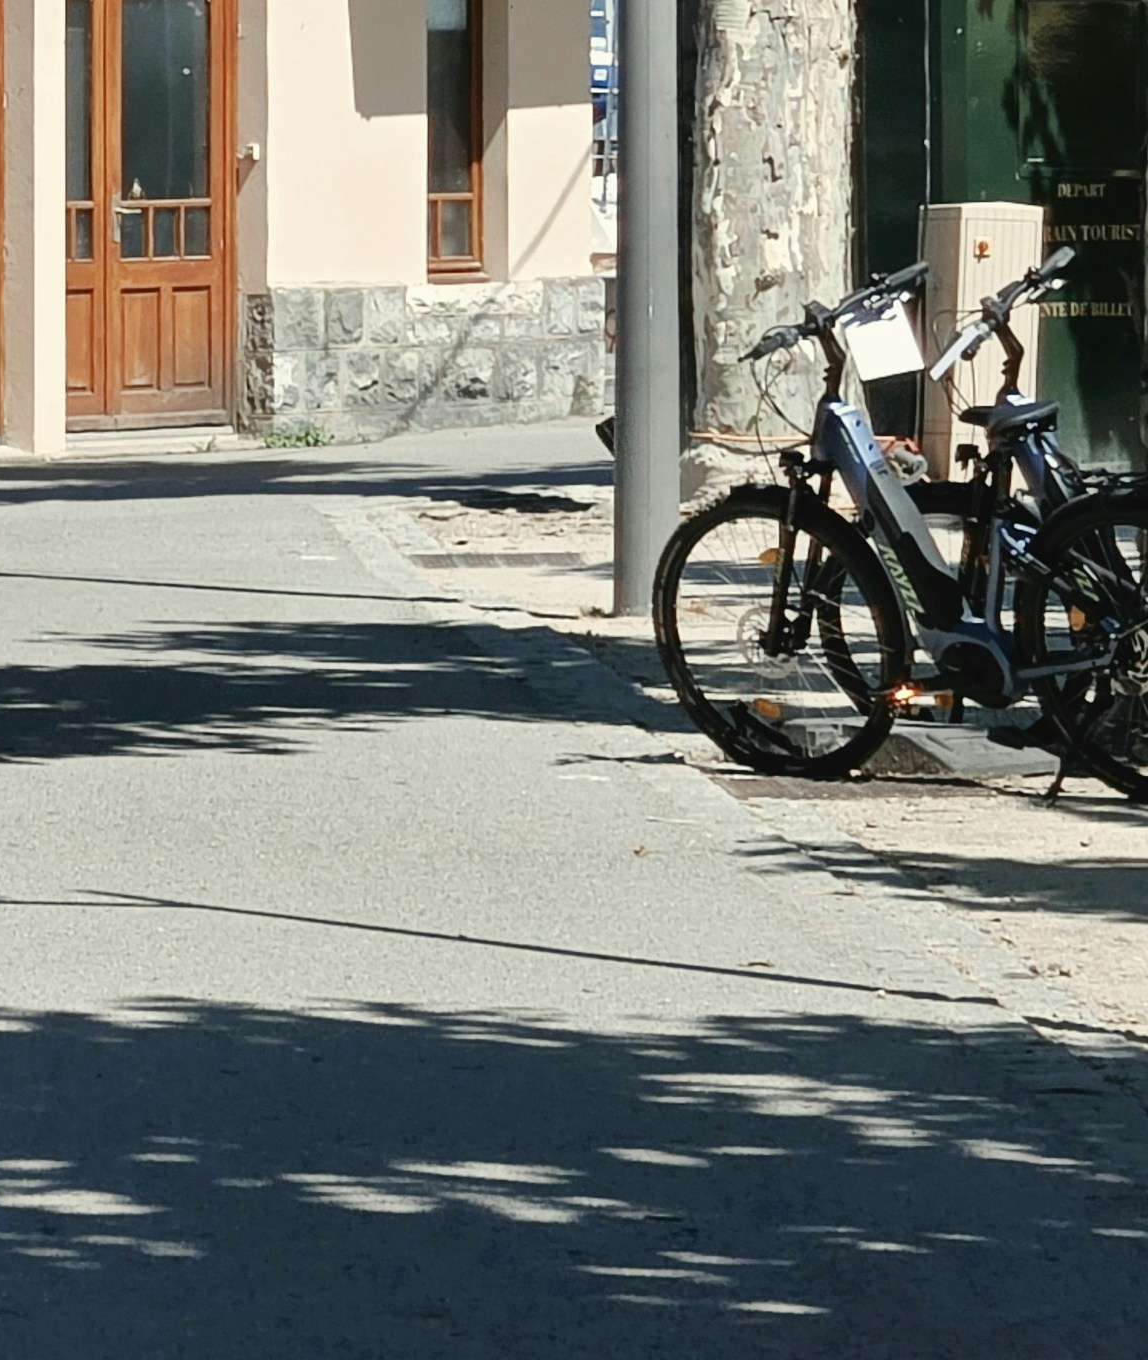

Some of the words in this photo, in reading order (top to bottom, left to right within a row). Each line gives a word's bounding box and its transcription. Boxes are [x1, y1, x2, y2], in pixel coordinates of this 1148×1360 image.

[1043, 224, 1077, 241] RAIN
[1039, 301, 1067, 317] NTE
[1070, 301, 1088, 317] DE
